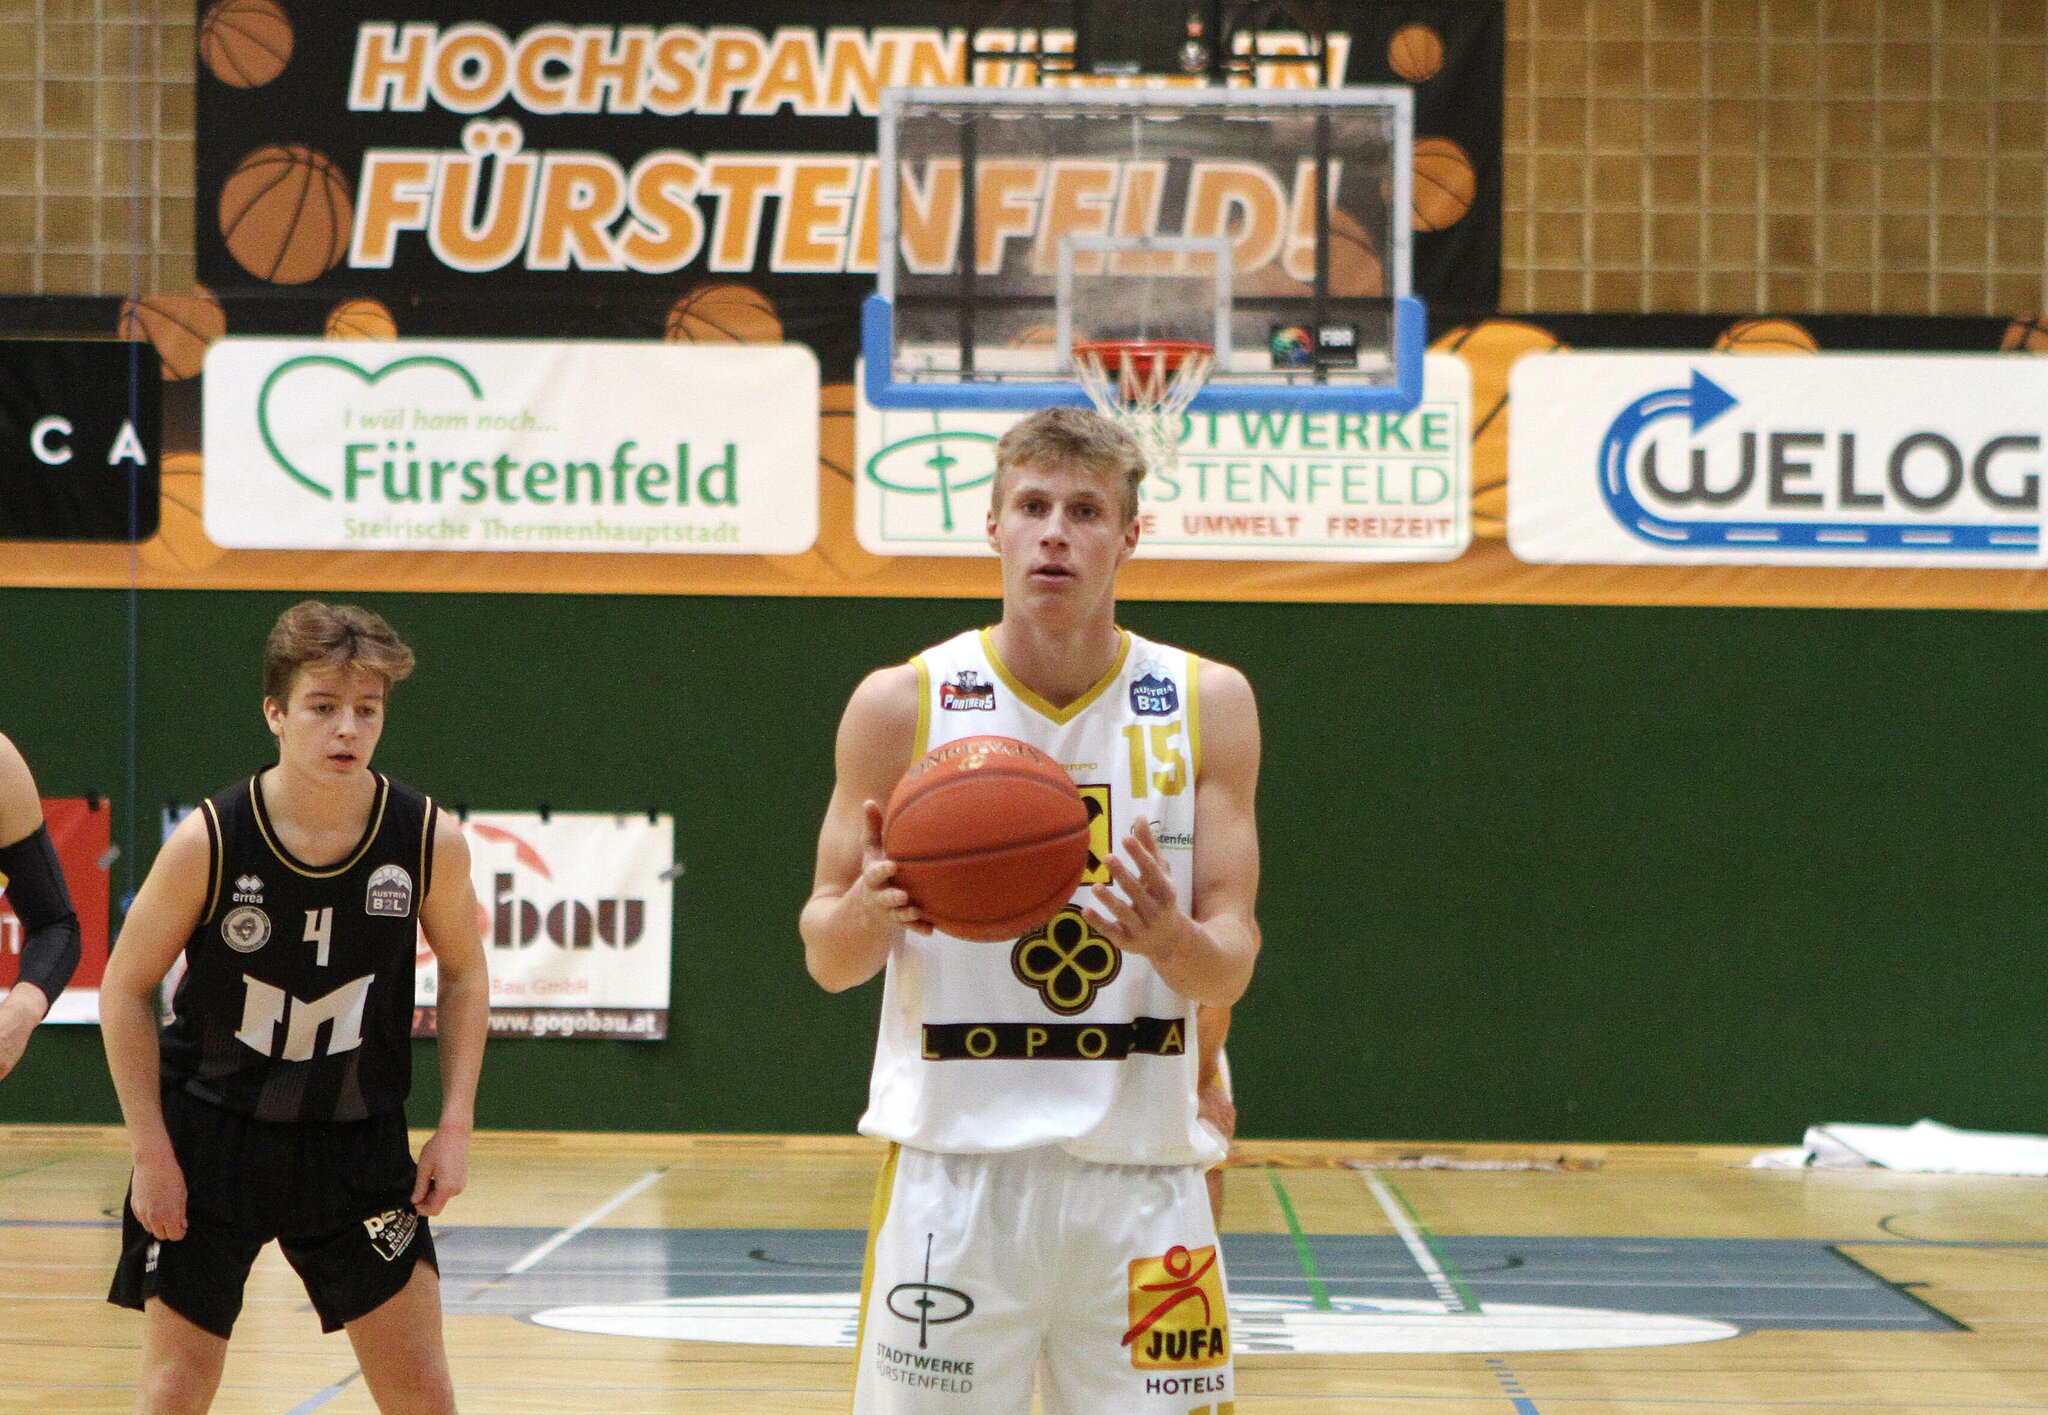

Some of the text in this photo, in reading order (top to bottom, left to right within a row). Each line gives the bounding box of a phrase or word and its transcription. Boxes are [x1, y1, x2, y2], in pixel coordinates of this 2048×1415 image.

[413, 408, 468, 431] ham
[344, 441, 739, 507] Fürstenfeld
[1641, 430, 2040, 513] WELOG
[344, 517, 741, 546] Steirische Thermenhauptstadt
[1182, 515, 1301, 536] UMWELT
[1327, 516, 1453, 538] FREIZEIT
[1133, 685, 1175, 696] AUSTRIA
[1137, 695, 1172, 712] B2L
[1122, 721, 1188, 798] 15
[372, 889, 407, 900] AUSTRIA
[372, 899, 403, 912] B2L
[302, 906, 334, 967] 4
[922, 1023, 1184, 1059] LOPOA
[1145, 1326, 1224, 1361] JUFA
[876, 1342, 974, 1376] STADTWERKE
[1146, 1374, 1225, 1395] HOTELS
